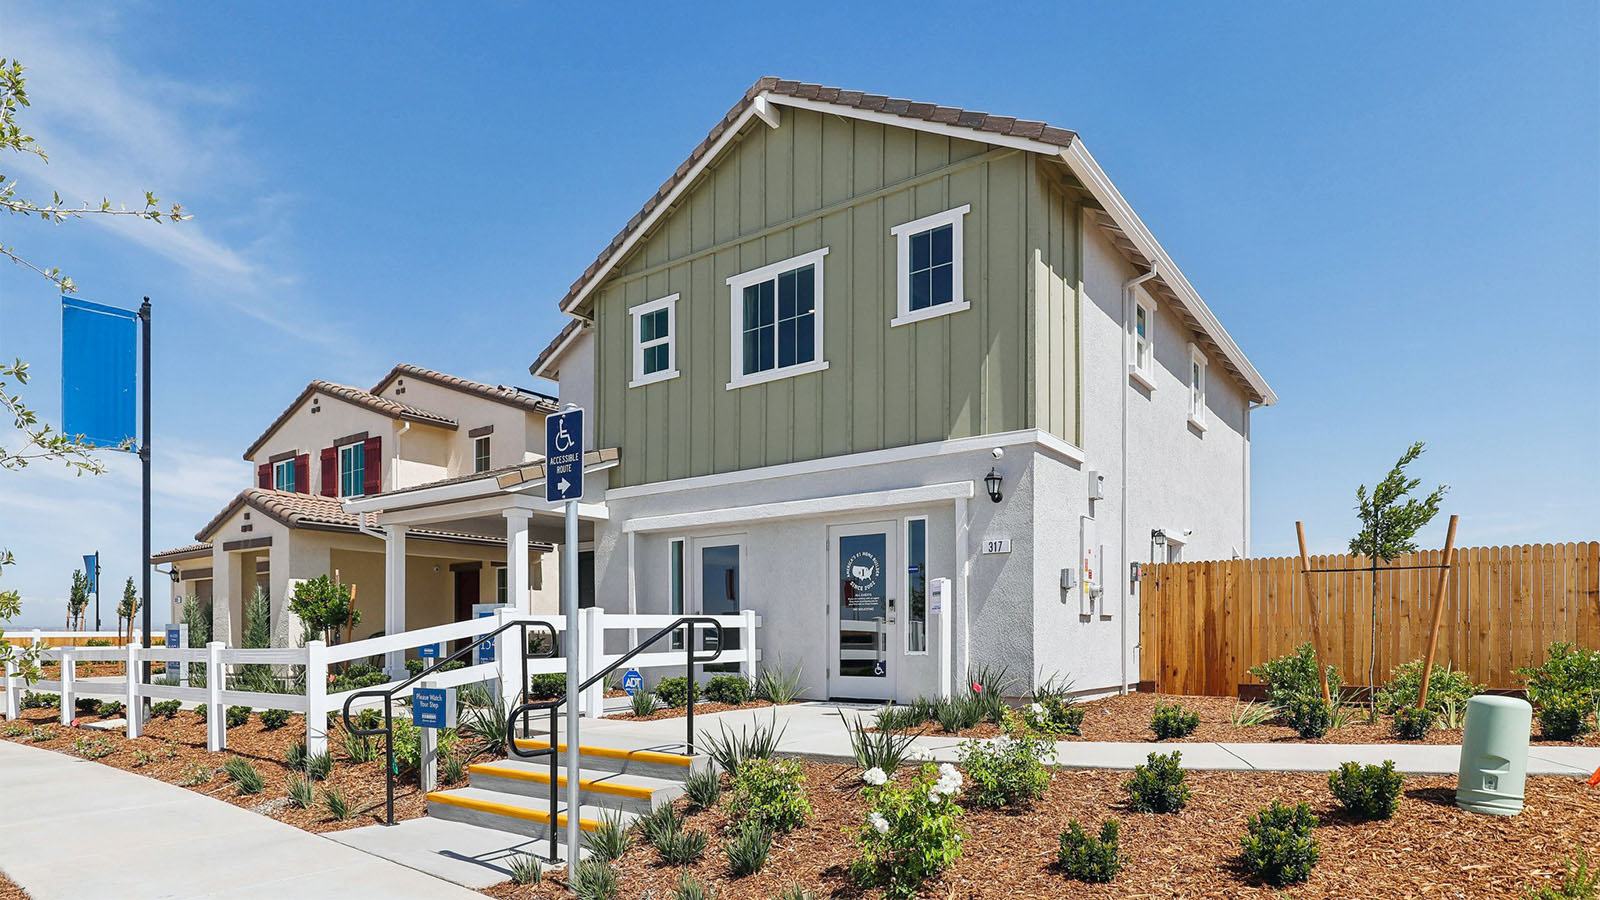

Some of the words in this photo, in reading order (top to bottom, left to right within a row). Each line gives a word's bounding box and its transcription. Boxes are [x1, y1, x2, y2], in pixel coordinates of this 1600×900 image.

[549, 453, 579, 465] ACCESSIBLE
[556, 464, 572, 474] ROUTE
[988, 541, 1002, 552] 317
[862, 551, 873, 559] HOME
[849, 581, 864, 591] SINCE
[625, 678, 641, 688] ADT
[416, 692, 429, 700] Please
[429, 701, 439, 709] Step
